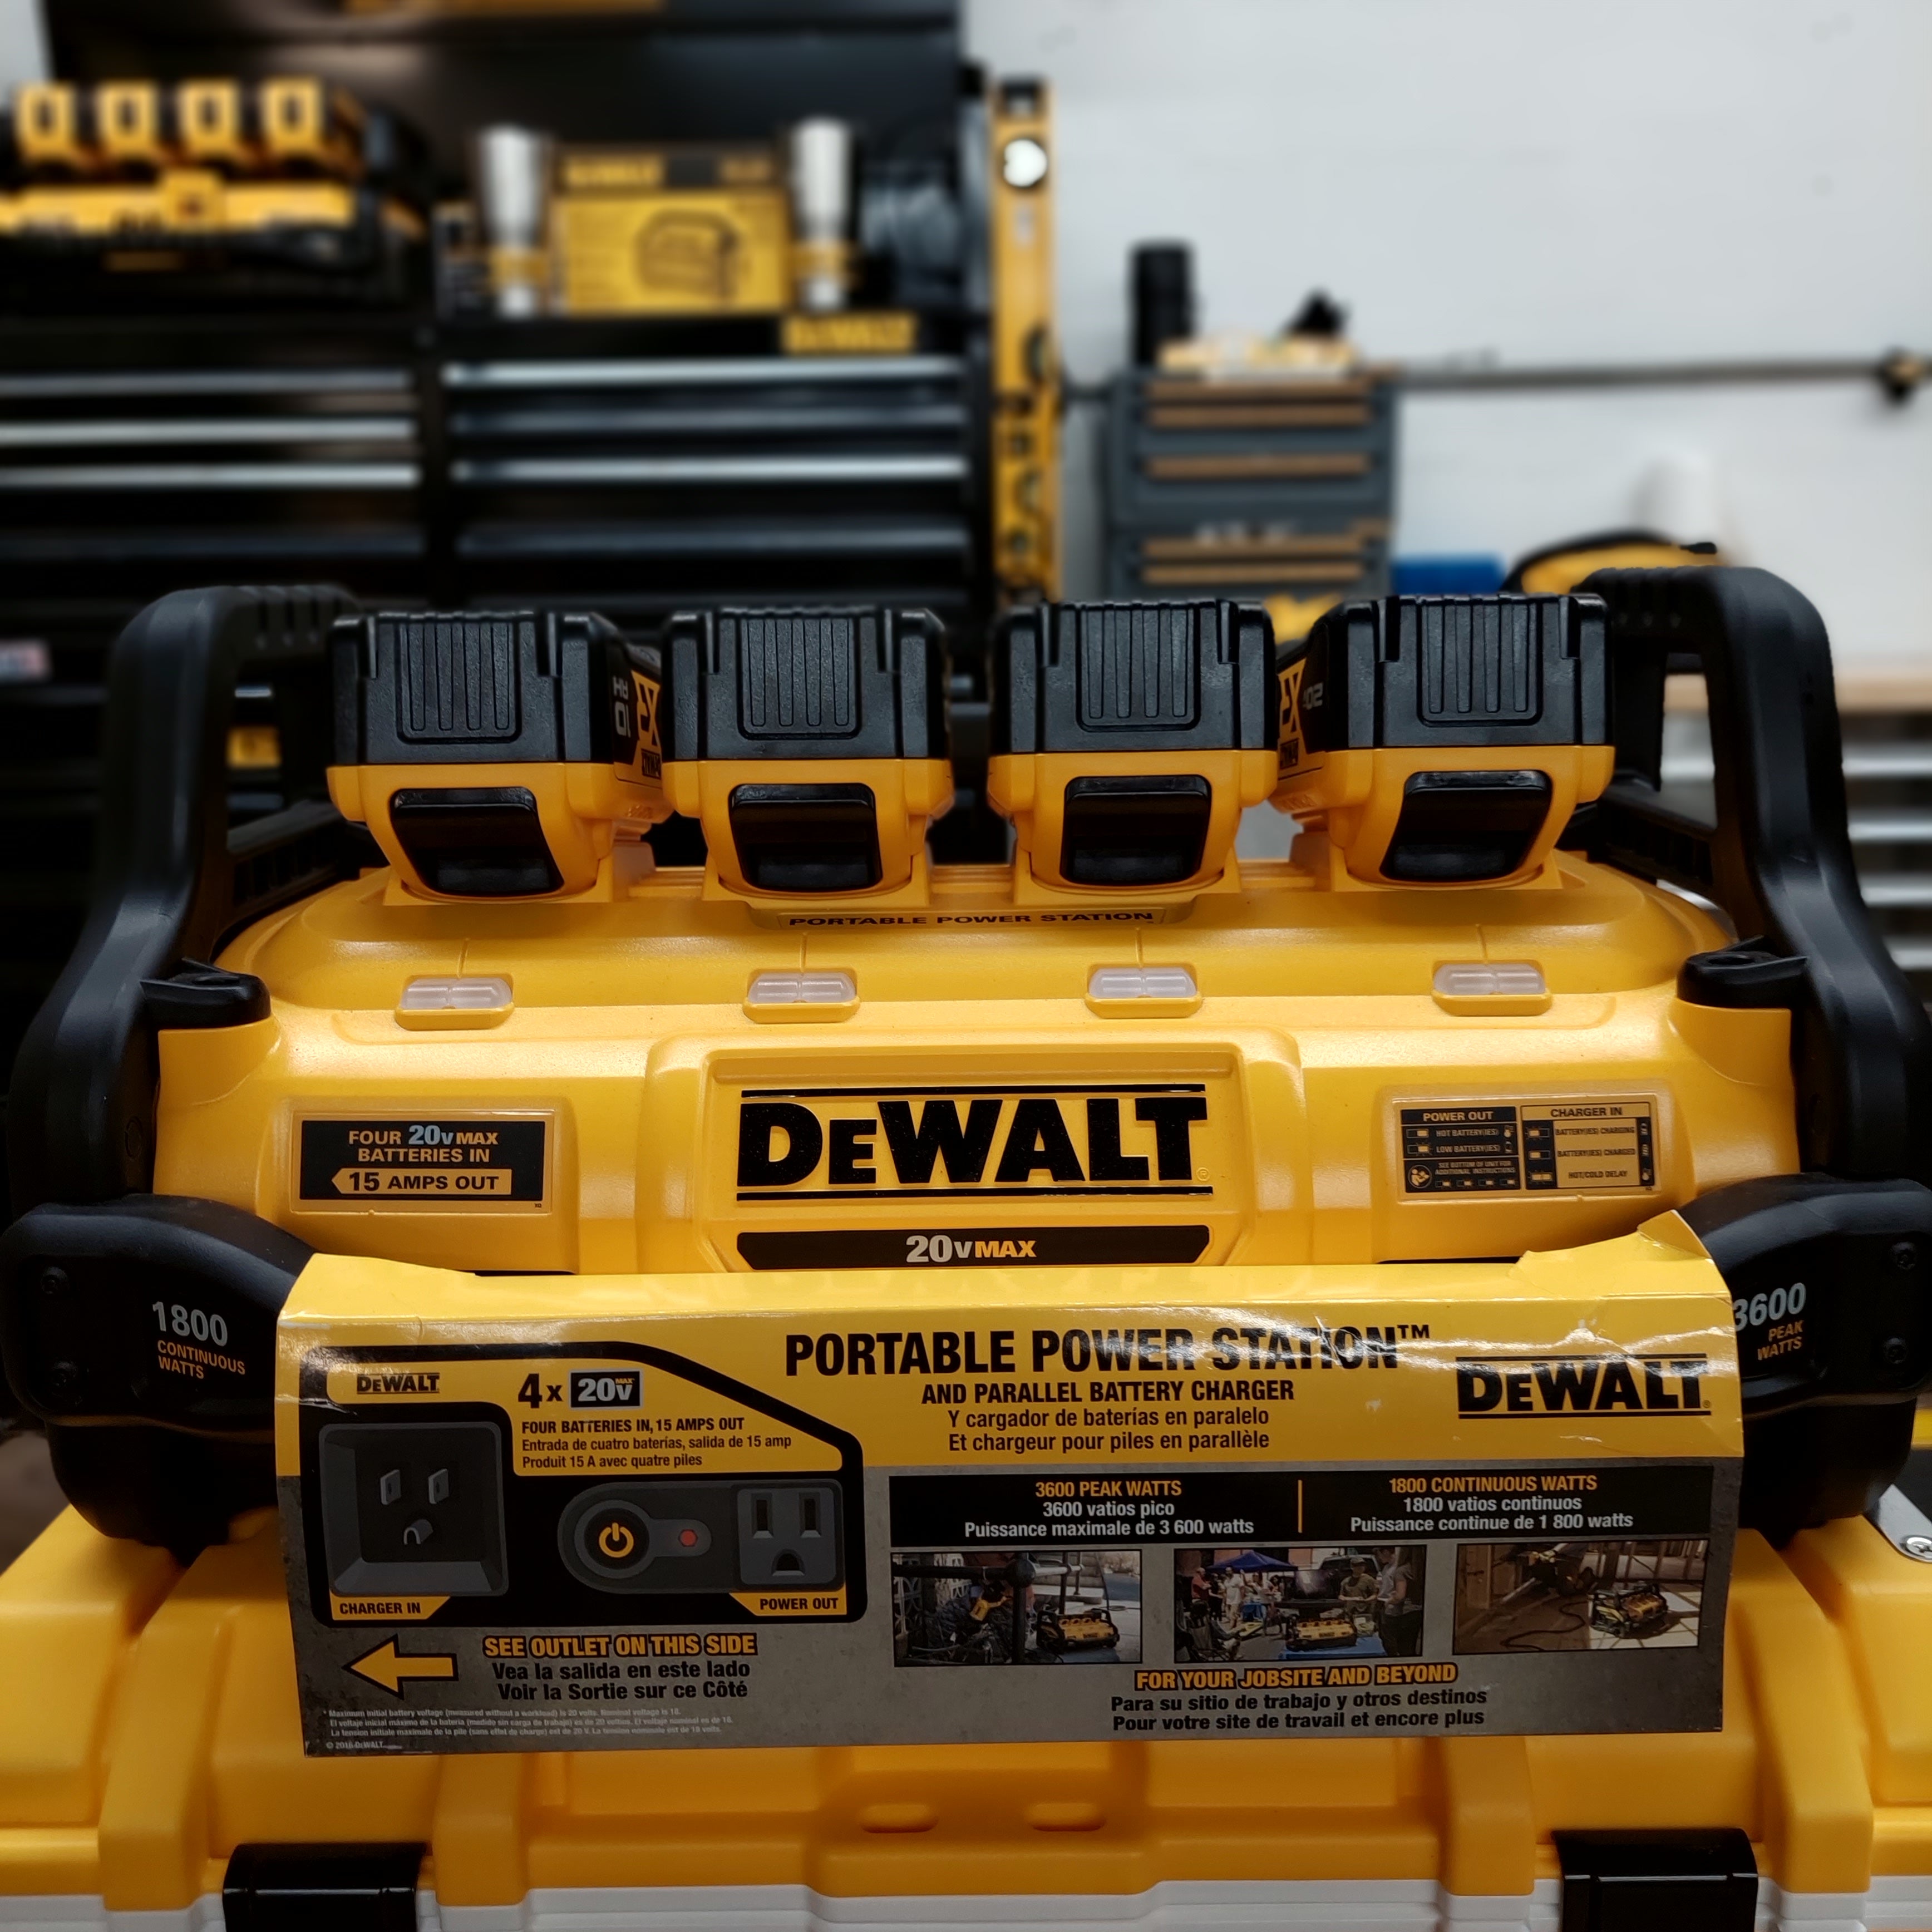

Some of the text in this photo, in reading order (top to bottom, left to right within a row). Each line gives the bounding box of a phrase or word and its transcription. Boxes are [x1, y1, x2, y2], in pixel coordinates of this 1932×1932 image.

[790, 917, 925, 925] PORTABLE
[1041, 913, 1153, 923] STATION
[1423, 1111, 1493, 1121] POWER OUT
[1551, 1107, 1622, 1117] CHARGER IN
[349, 1131, 401, 1144] FOUR
[358, 1149, 489, 1162] BATTERIES IN
[349, 1172, 499, 1191] 15 AMPS OUT
[1733, 1282, 1807, 1332] 3600
[152, 1301, 228, 1347] 1800
[1768, 1320, 1804, 1342] PEAK
[157, 1340, 245, 1375] CONTINUOUS
[786, 1332, 1016, 1377] PORTABLE
[1032, 1328, 1204, 1373] POWER
[1757, 1336, 1802, 1361] WATTS
[158, 1356, 204, 1379] WATTS
[518, 1374, 542, 1408] 4
[922, 1379, 1293, 1404] AND PARALLEL BATTERY CHARGER
[523, 1417, 744, 1434] FOUR BATTERIES IN, 15 AMPS OUT
[948, 1406, 1268, 1431] Y cargador de baterías en paralelo
[523, 1435, 791, 1451] Entrada de cuatro baterías, salida de 15 amp
[949, 1430, 1269, 1454] Et chargeur pour piles en parallèle
[523, 1453, 702, 1469] Produit 15 A avec quatre piles
[1036, 1480, 1181, 1497] 3600 PEAK WATTS
[1389, 1475, 1597, 1493] 1800 CONTINUOUS WATTS
[1043, 1500, 1174, 1519] 3600 vatios pico
[1404, 1495, 1581, 1512] 1800 vatios continuos
[965, 1522, 1047, 1537] Puissance
[1052, 1520, 1130, 1536] maximale
[1136, 1521, 1155, 1535] de
[1209, 1519, 1254, 1534] watts
[1351, 1517, 1434, 1532] Puissance
[1438, 1515, 1509, 1530] continue
[1514, 1515, 1534, 1529] de
[1588, 1513, 1633, 1527] watts
[340, 1602, 420, 1614] CHARGER IN
[760, 1598, 838, 1610] POWER OUT
[485, 1635, 756, 1657] SEE OUTLET ON THIS SIDE
[492, 1660, 750, 1680] Vea la salida en este lado
[1136, 1664, 1457, 1689] FOR YOUR JOBSITE AND BEYOND
[496, 1680, 747, 1702] Voir la Sortie sur ce Côté
[1112, 1689, 1487, 1712] Para su sitio de trabajo y otros destinos
[389, 1709, 415, 1718] battery
[1113, 1709, 1484, 1731] Pour votre site de travail et encore plus
